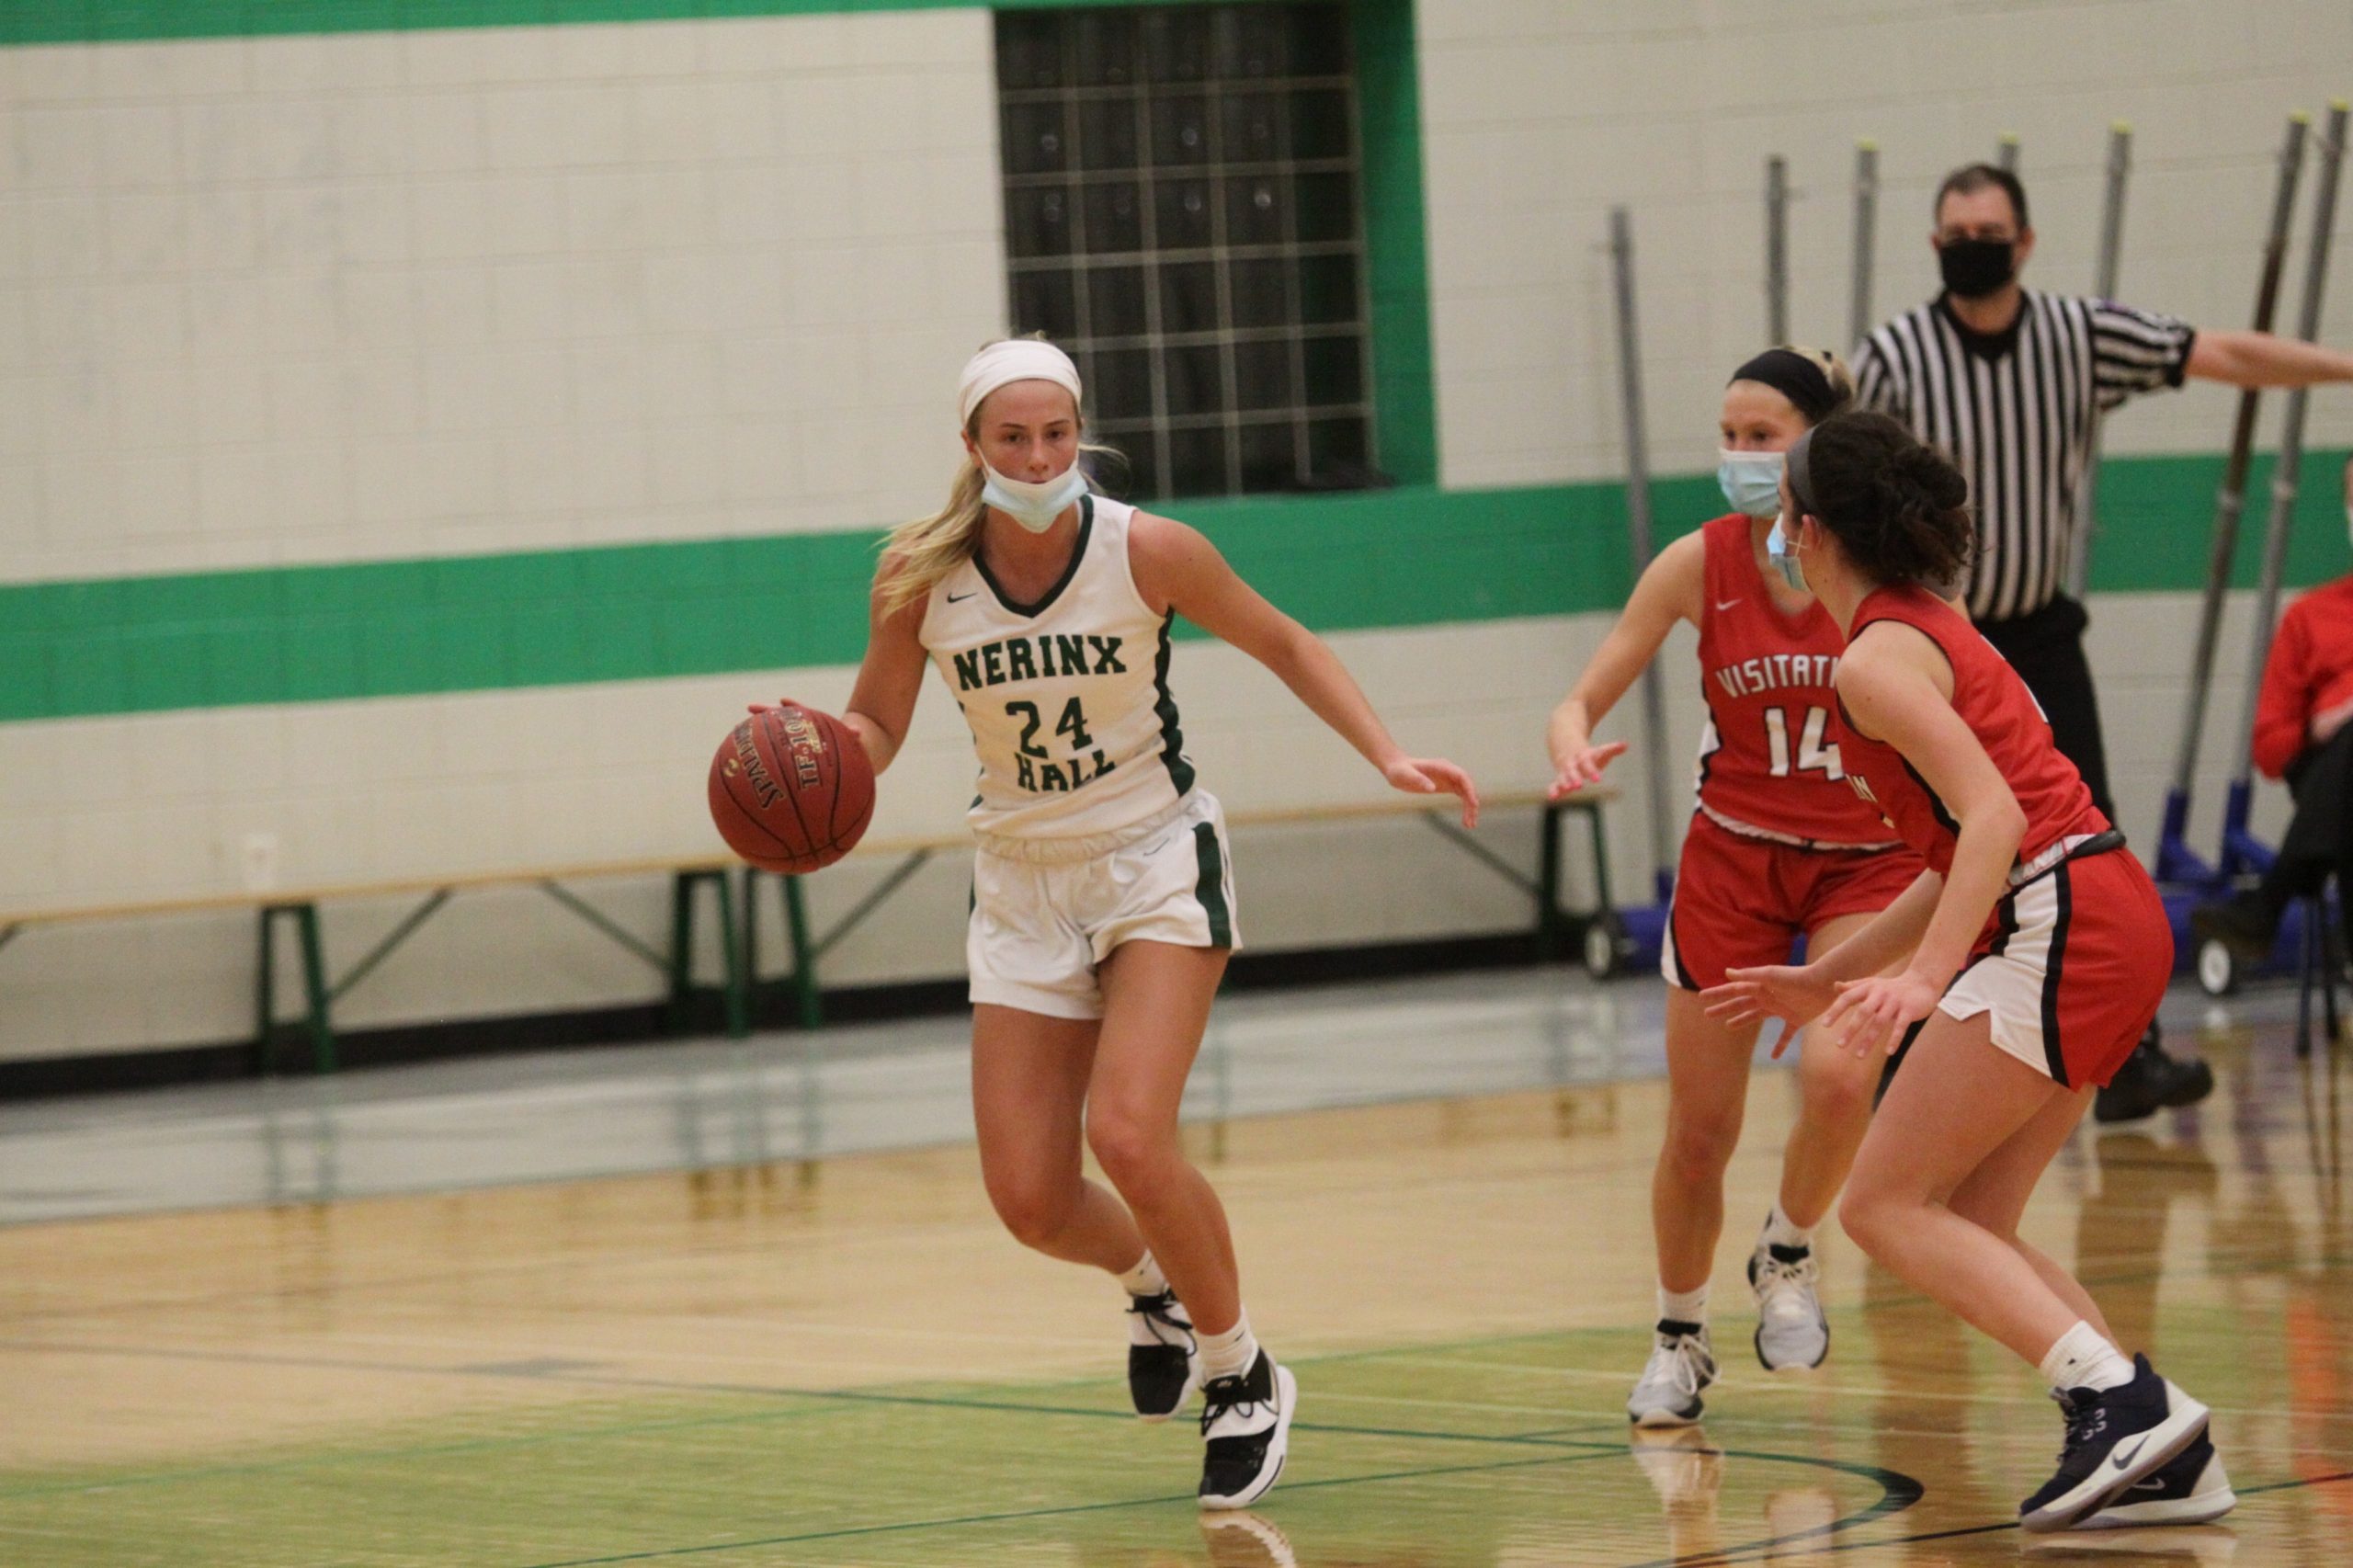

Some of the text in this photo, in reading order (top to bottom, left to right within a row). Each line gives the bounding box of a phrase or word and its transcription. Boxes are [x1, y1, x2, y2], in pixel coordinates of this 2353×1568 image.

[952, 634, 1127, 690] NERINX
[1717, 654, 1838, 698] VISITATI
[1005, 696, 1094, 759] 24
[1765, 707, 1844, 780] 14
[734, 721, 785, 810] SPALDIN
[1014, 748, 1117, 792] HALL
